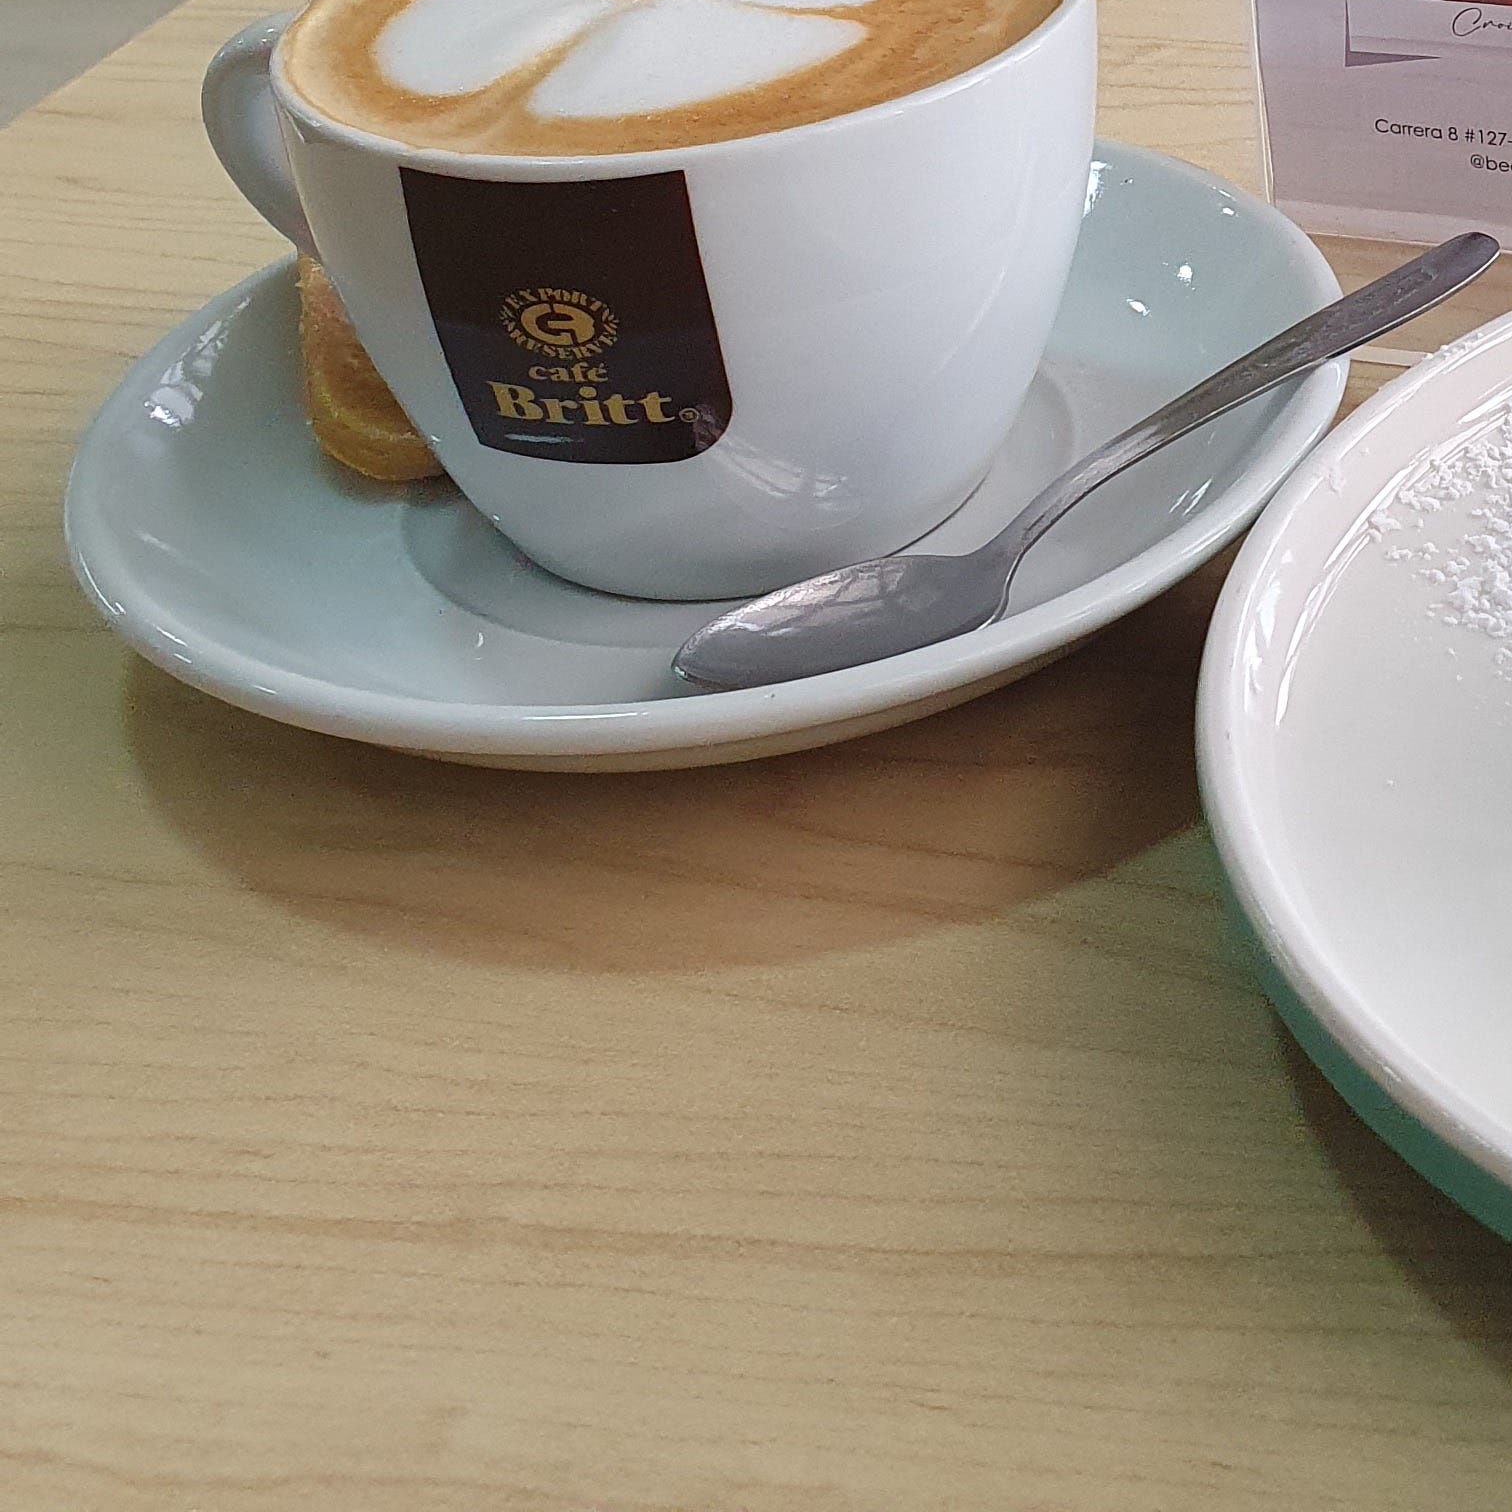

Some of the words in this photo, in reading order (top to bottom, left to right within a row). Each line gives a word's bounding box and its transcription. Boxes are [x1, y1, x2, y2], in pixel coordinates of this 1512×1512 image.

[1374, 118, 1443, 140] Carrera
[1447, 126, 1459, 142] 8
[528, 361, 609, 384] café
[487, 380, 676, 426] Britt
